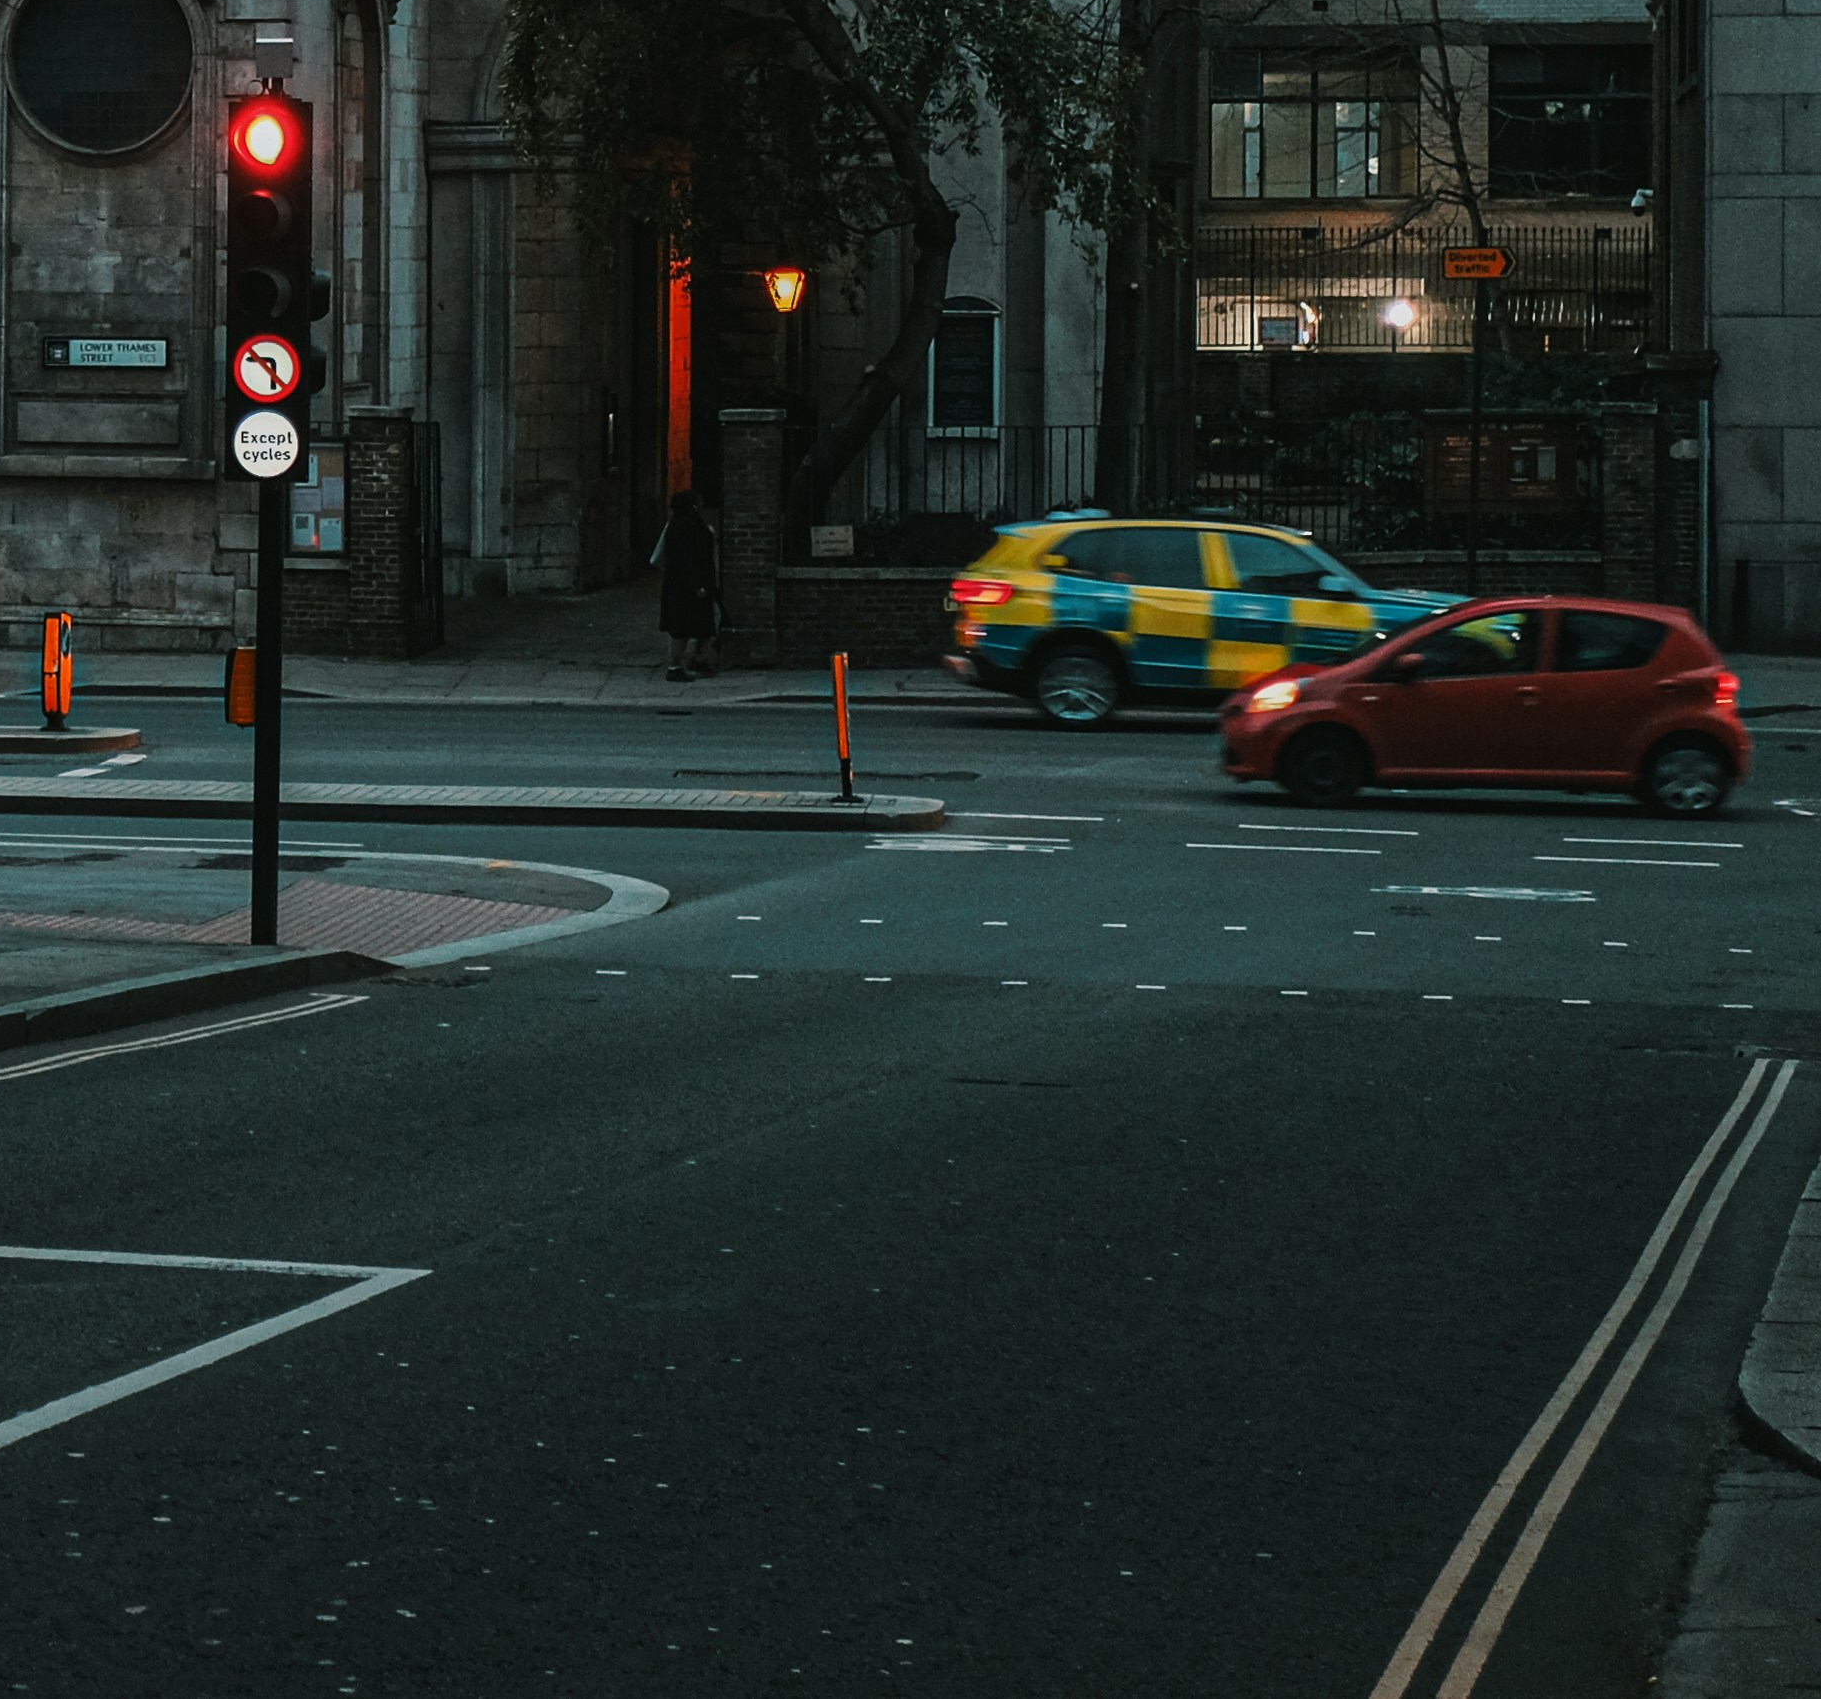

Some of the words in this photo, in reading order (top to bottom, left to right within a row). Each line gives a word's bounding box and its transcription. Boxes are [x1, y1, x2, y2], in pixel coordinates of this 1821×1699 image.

[1449, 252, 1496, 262] Diverted
[1455, 264, 1490, 273] traffic
[80, 343, 113, 352] LOWER
[117, 343, 156, 353] THAMES
[80, 353, 113, 362] STREET
[241, 430, 293, 446] Except
[243, 447, 291, 464] cycles
